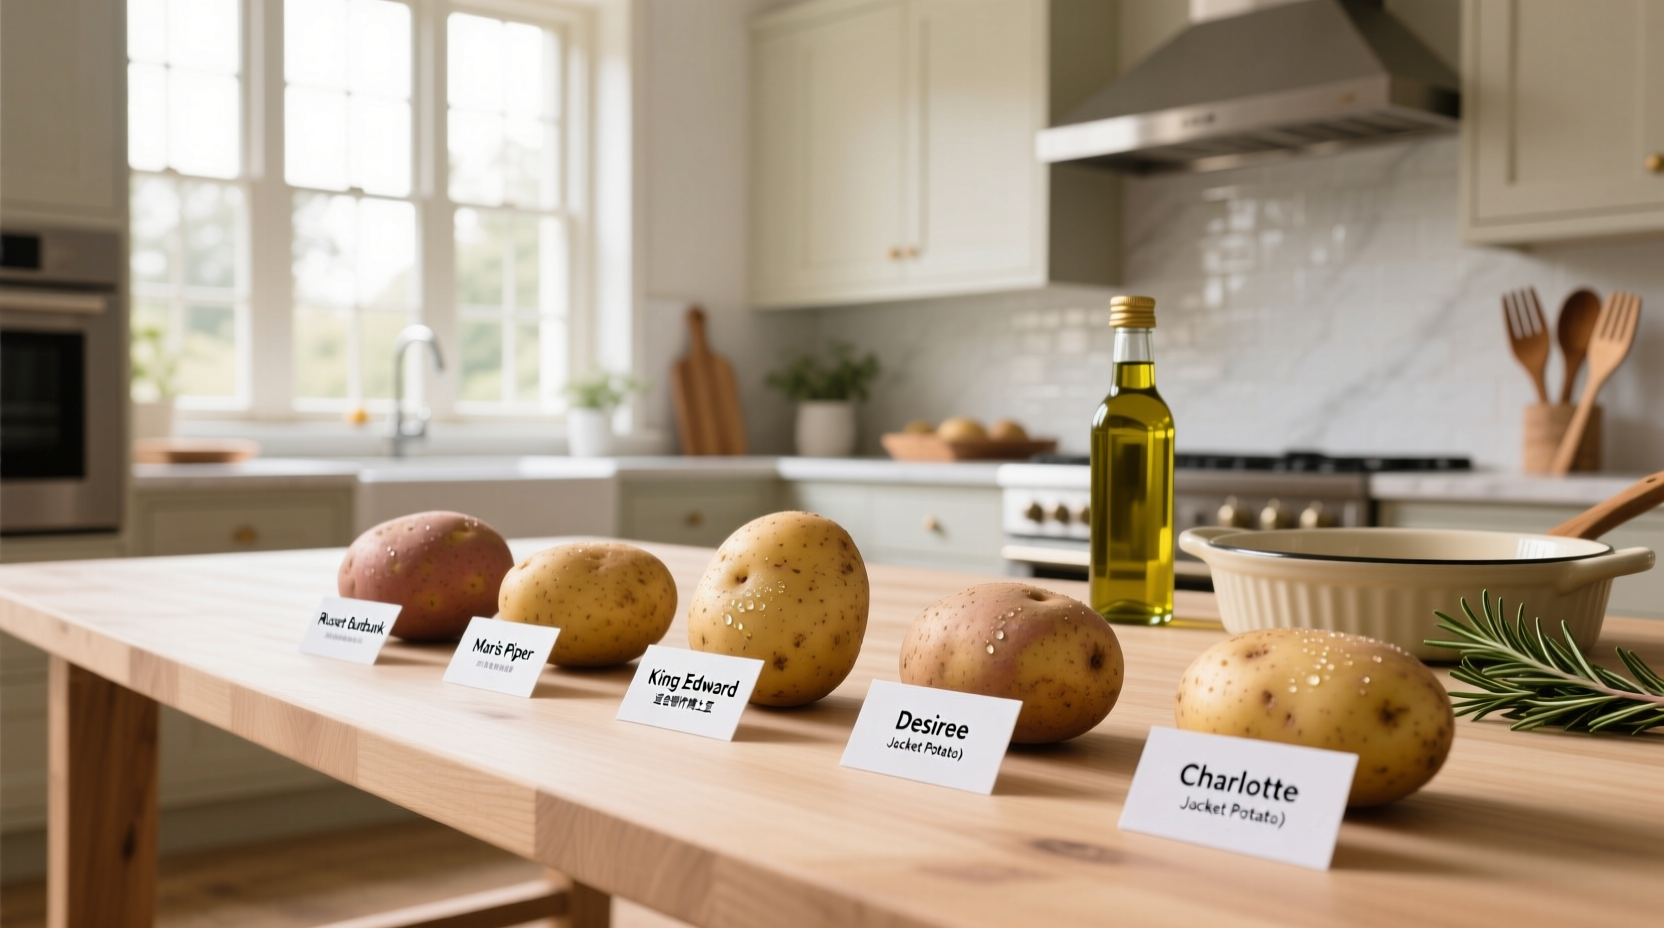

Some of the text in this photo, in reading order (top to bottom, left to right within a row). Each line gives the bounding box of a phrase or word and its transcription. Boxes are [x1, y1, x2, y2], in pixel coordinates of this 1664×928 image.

[648, 668, 740, 698] King Edward
[895, 709, 969, 740] Desiree
[886, 736, 964, 762] Jacket Potato)
[1180, 762, 1299, 803] Charlotte
[1179, 795, 1286, 829] Jacket Potato)
